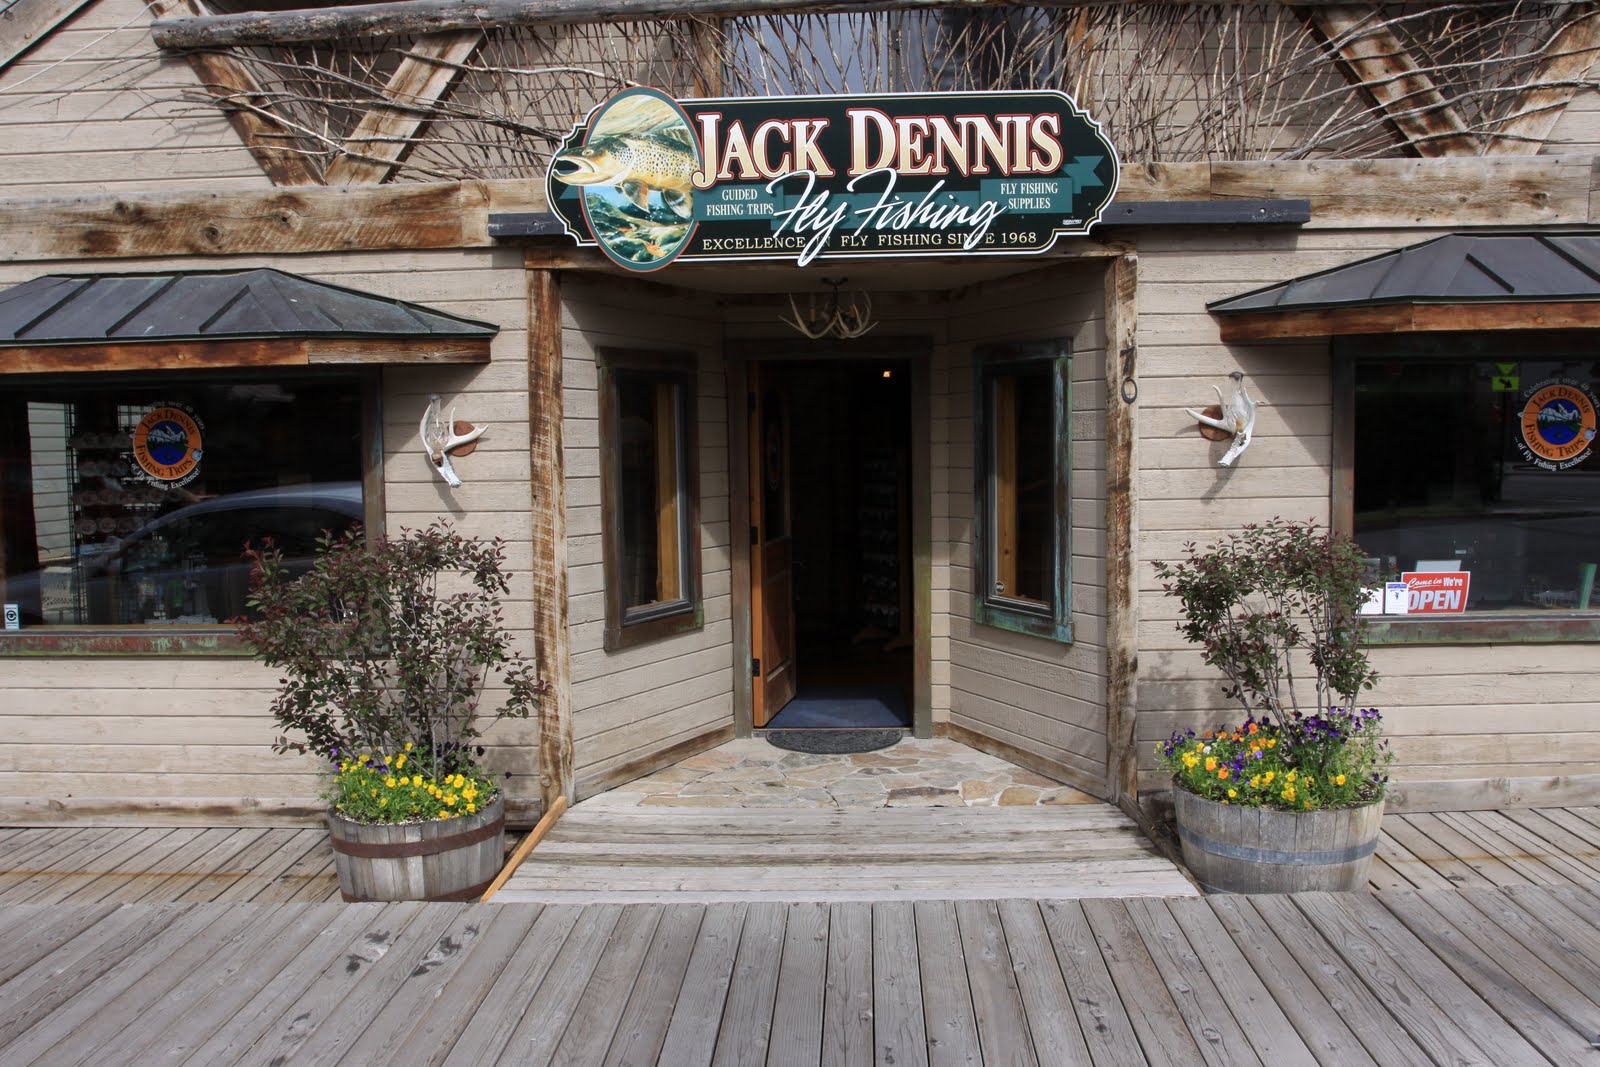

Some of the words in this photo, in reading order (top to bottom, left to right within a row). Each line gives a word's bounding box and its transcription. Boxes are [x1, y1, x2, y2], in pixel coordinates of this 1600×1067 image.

[691, 111, 835, 190] JACK
[846, 107, 1064, 177] DENNIS
[721, 189, 758, 201] GUIDED
[1000, 183, 1018, 195] FLY
[1020, 182, 1058, 195] FISHING
[706, 203, 744, 216] FISHING
[748, 203, 774, 215] TRIPS
[1008, 197, 1051, 210] SUPPLIES
[765, 169, 847, 268] Fly
[846, 168, 1007, 250] Fishing
[702, 236, 806, 250] EXCELLENCE
[840, 235, 869, 247] FLY
[878, 234, 944, 246] FISHING
[1001, 232, 1037, 244] 1968
[1532, 389, 1557, 408] JACK
[1558, 387, 1591, 414] DENNIS
[165, 409, 195, 435] DENNIS
[1525, 423, 1553, 457] FISHING
[1556, 438, 1585, 457] TRIPS
[135, 444, 164, 476] FISHING
[167, 458, 193, 477] TRIPS
[1534, 458, 1557, 472] Fishing
[1559, 447, 1593, 470] Excellence!
[147, 479, 169, 491] Fishing
[170, 467, 201, 489] Excellence!
[1408, 577, 1433, 587] Come
[1443, 577, 1463, 586] We're
[1408, 589, 1462, 610] OPEN
